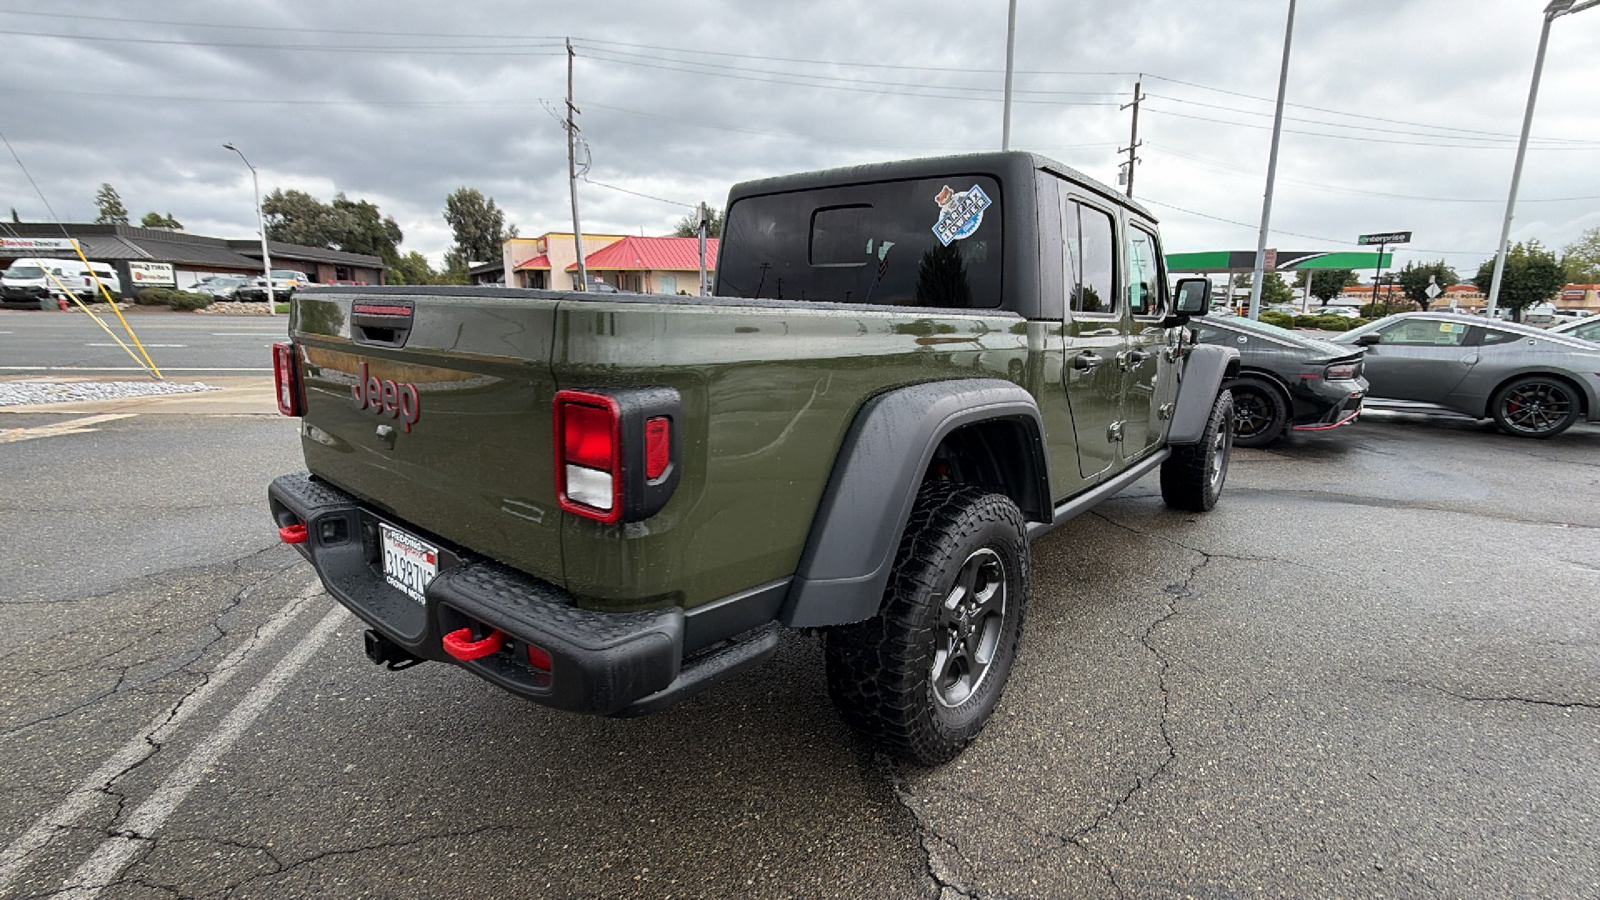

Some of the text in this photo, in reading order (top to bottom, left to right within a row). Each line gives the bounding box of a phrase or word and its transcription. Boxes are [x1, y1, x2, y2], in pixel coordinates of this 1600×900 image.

[937, 192, 980, 233] CARFAX
[950, 198, 986, 233] OWNER
[1359, 234, 1406, 244] enterprise
[350, 361, 420, 434] Jeep
[391, 530, 423, 551] REDDING
[393, 540, 424, 559] California
[386, 575, 408, 594] CROWN
